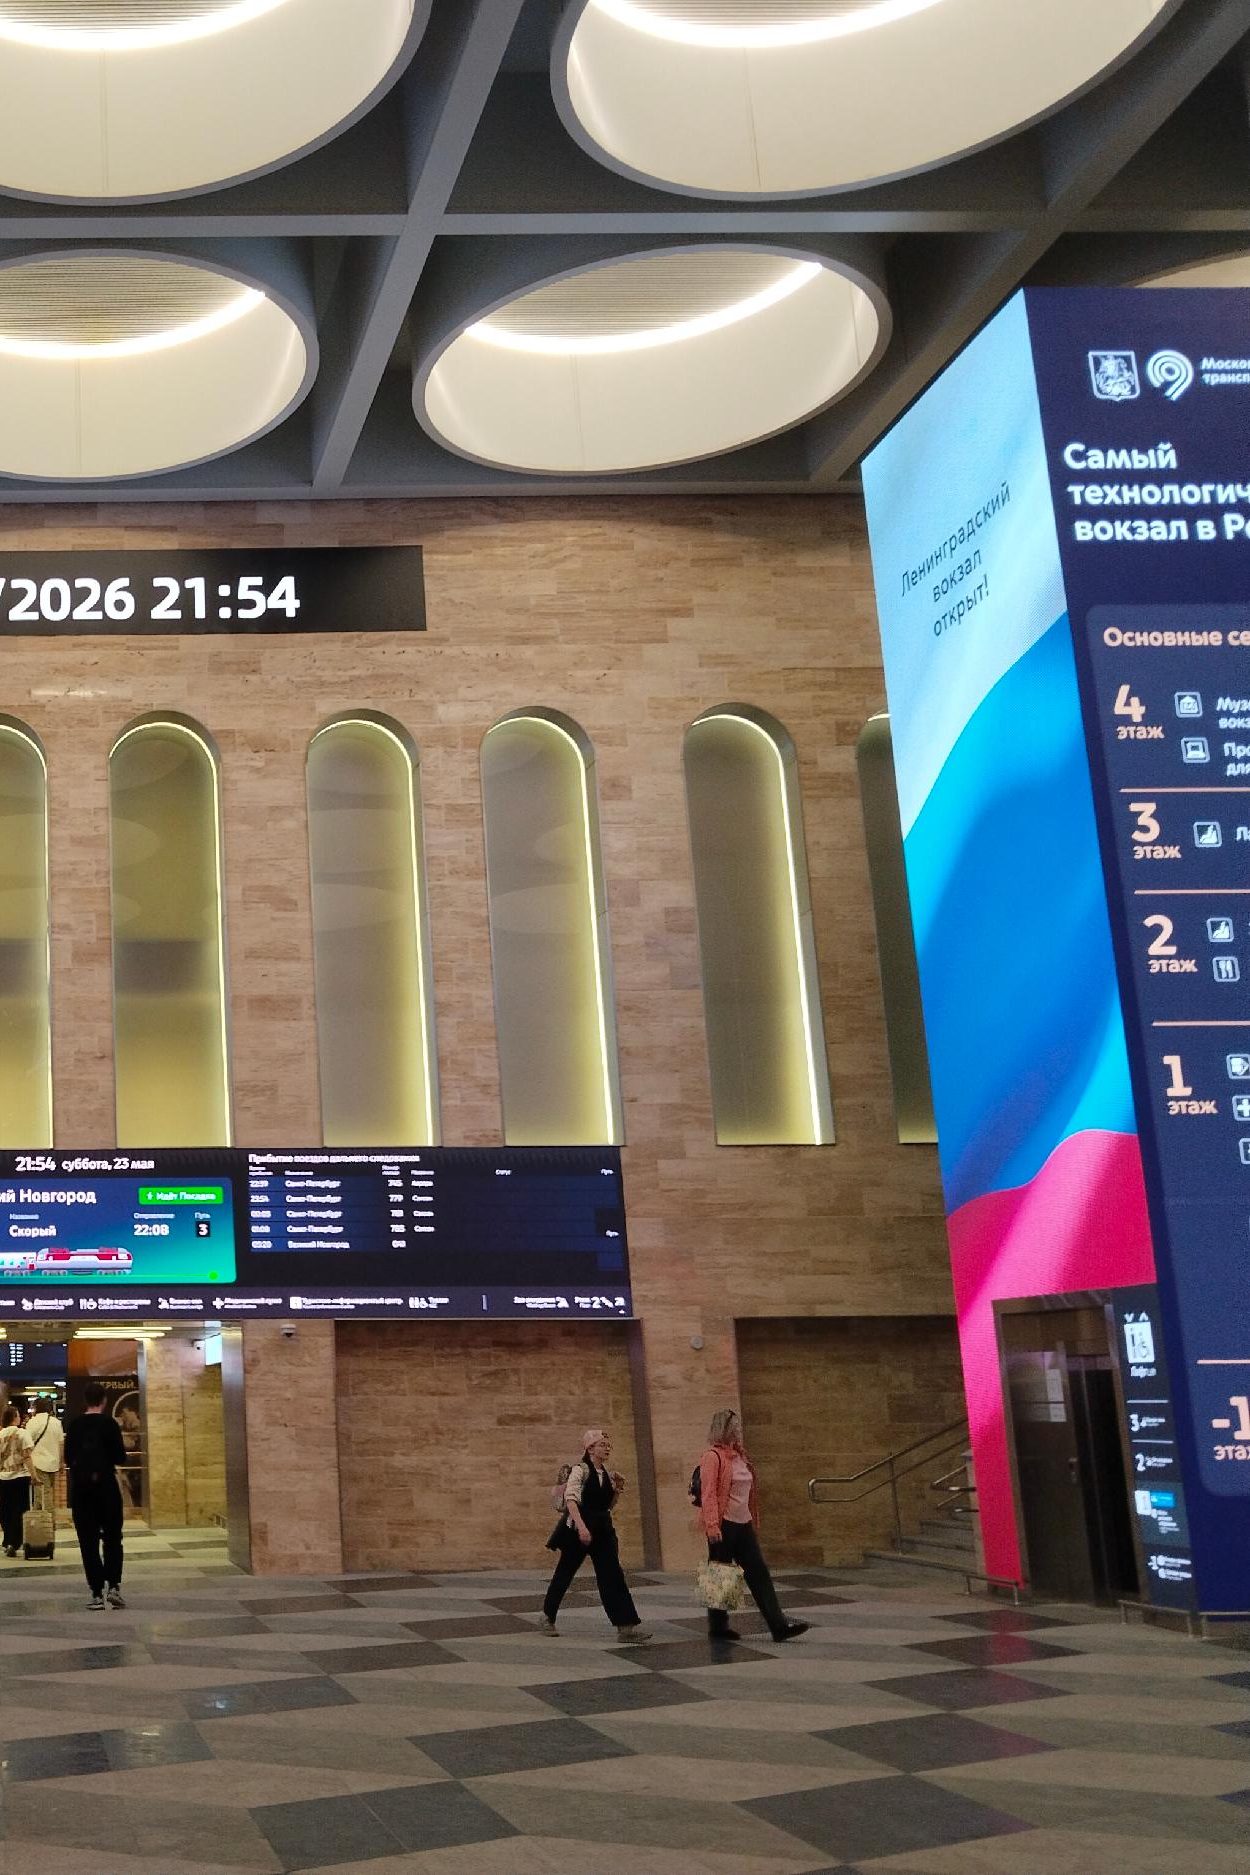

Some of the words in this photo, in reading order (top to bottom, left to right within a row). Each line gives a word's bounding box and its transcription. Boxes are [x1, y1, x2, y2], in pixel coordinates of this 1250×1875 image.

[1202, 357, 1250, 370] Моско
[1063, 442, 1177, 470] Самый
[1068, 483, 1250, 505] технологич
[1074, 519, 1188, 541] вокзал
[1196, 520, 1216, 540] в
[1223, 513, 1250, 540] Р
[901, 482, 1011, 597] Ленинградский
[932, 548, 982, 602] вокзал
[150, 576, 301, 619] 21:54
[933, 575, 990, 637] открыт!
[1103, 626, 1222, 647] Основные
[1114, 684, 1146, 722] 4
[1216, 697, 1250, 713] Муз
[1116, 725, 1165, 739] этаж
[1129, 802, 1161, 842] 3
[1133, 846, 1181, 859] этаж
[1143, 914, 1177, 956] 2
[1148, 959, 1198, 973] этаж
[1162, 1055, 1193, 1096] 1
[1168, 1100, 1218, 1115] этаж
[15, 1157, 56, 1171] 21:54
[61, 1158, 112, 1170] суббота,
[113, 1158, 130, 1170] 23
[131, 1159, 154, 1169] мая
[19, 1189, 97, 1205] Новгород
[9, 1225, 56, 1238] Скорый
[134, 1224, 169, 1236] 22:08
[198, 1224, 208, 1236] 3
[1129, 1414, 1140, 1432] 3
[1214, 1445, 1250, 1460] эта
[1135, 1453, 1146, 1472] 2
